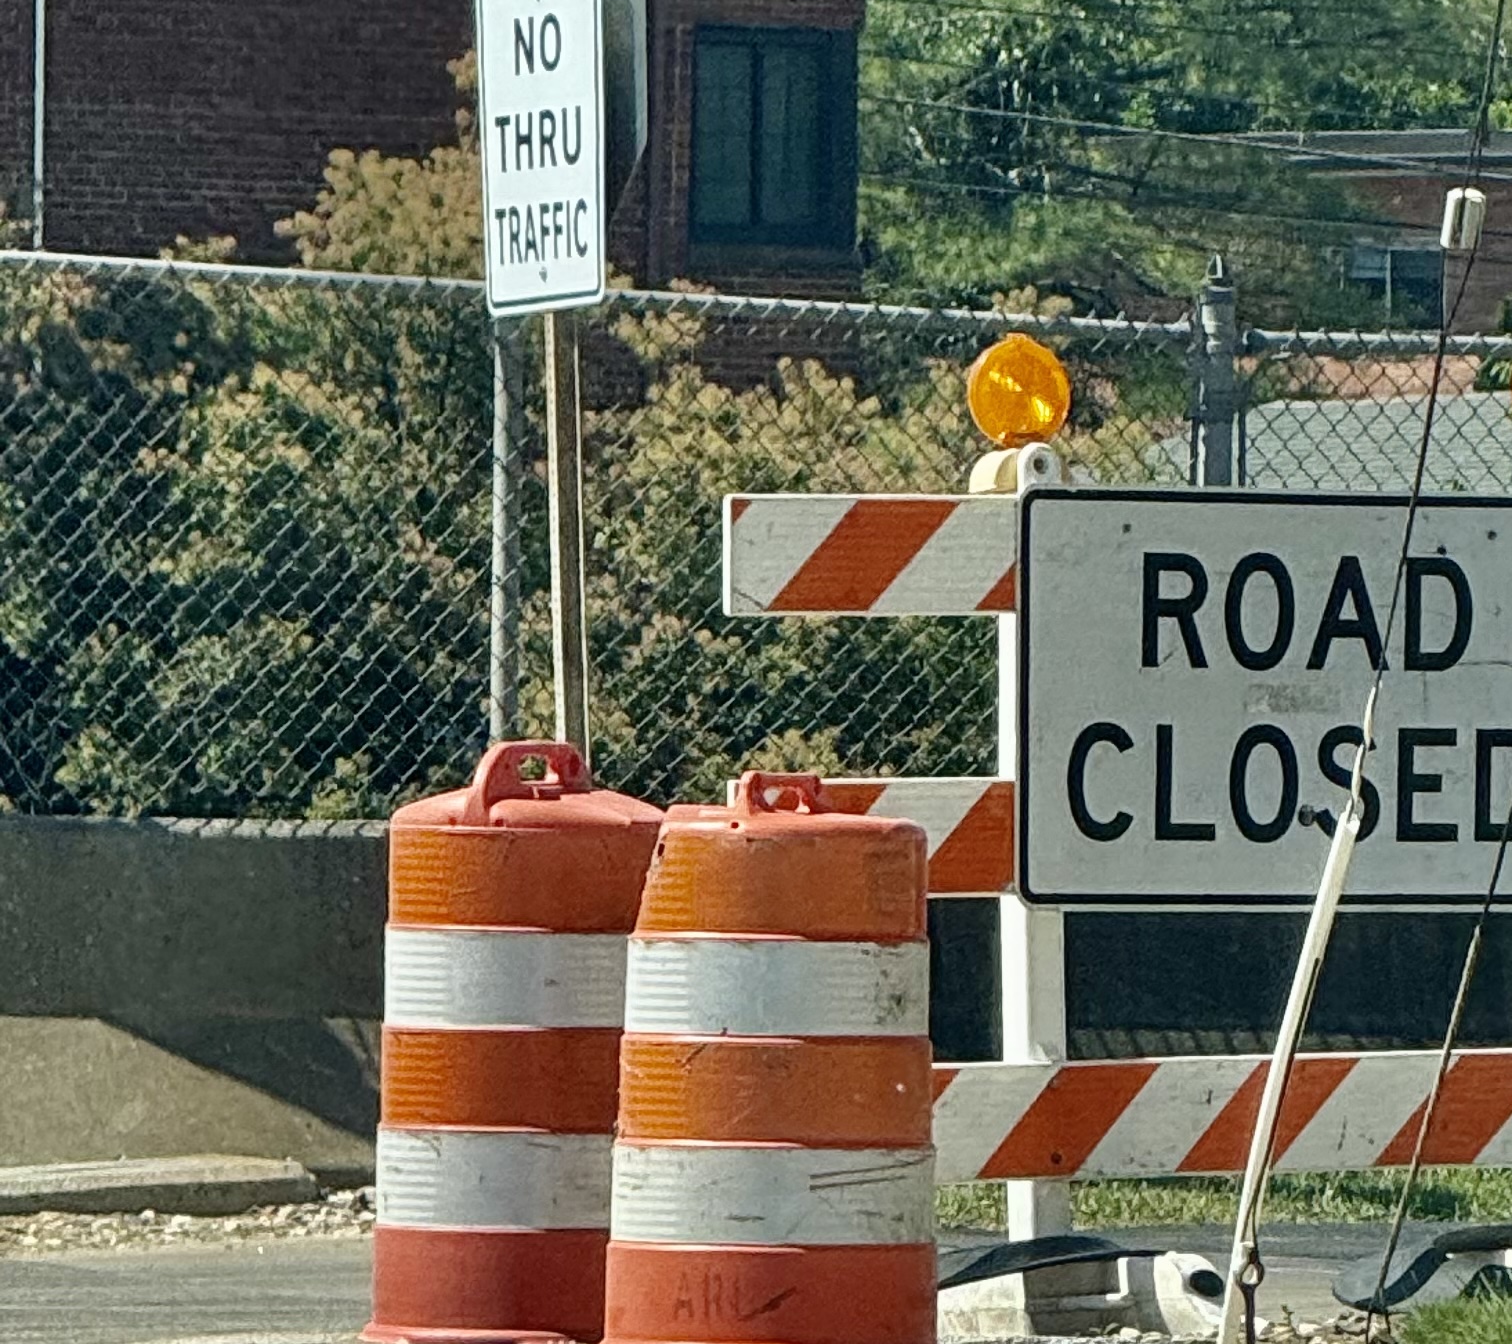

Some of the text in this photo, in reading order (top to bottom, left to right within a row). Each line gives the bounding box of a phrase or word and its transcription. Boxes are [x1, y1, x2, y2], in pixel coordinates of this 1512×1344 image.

[513, 12, 562, 76] NO
[494, 105, 582, 173] THRU
[494, 198, 588, 266] TRAFFIC
[1140, 551, 1474, 672] ROAD
